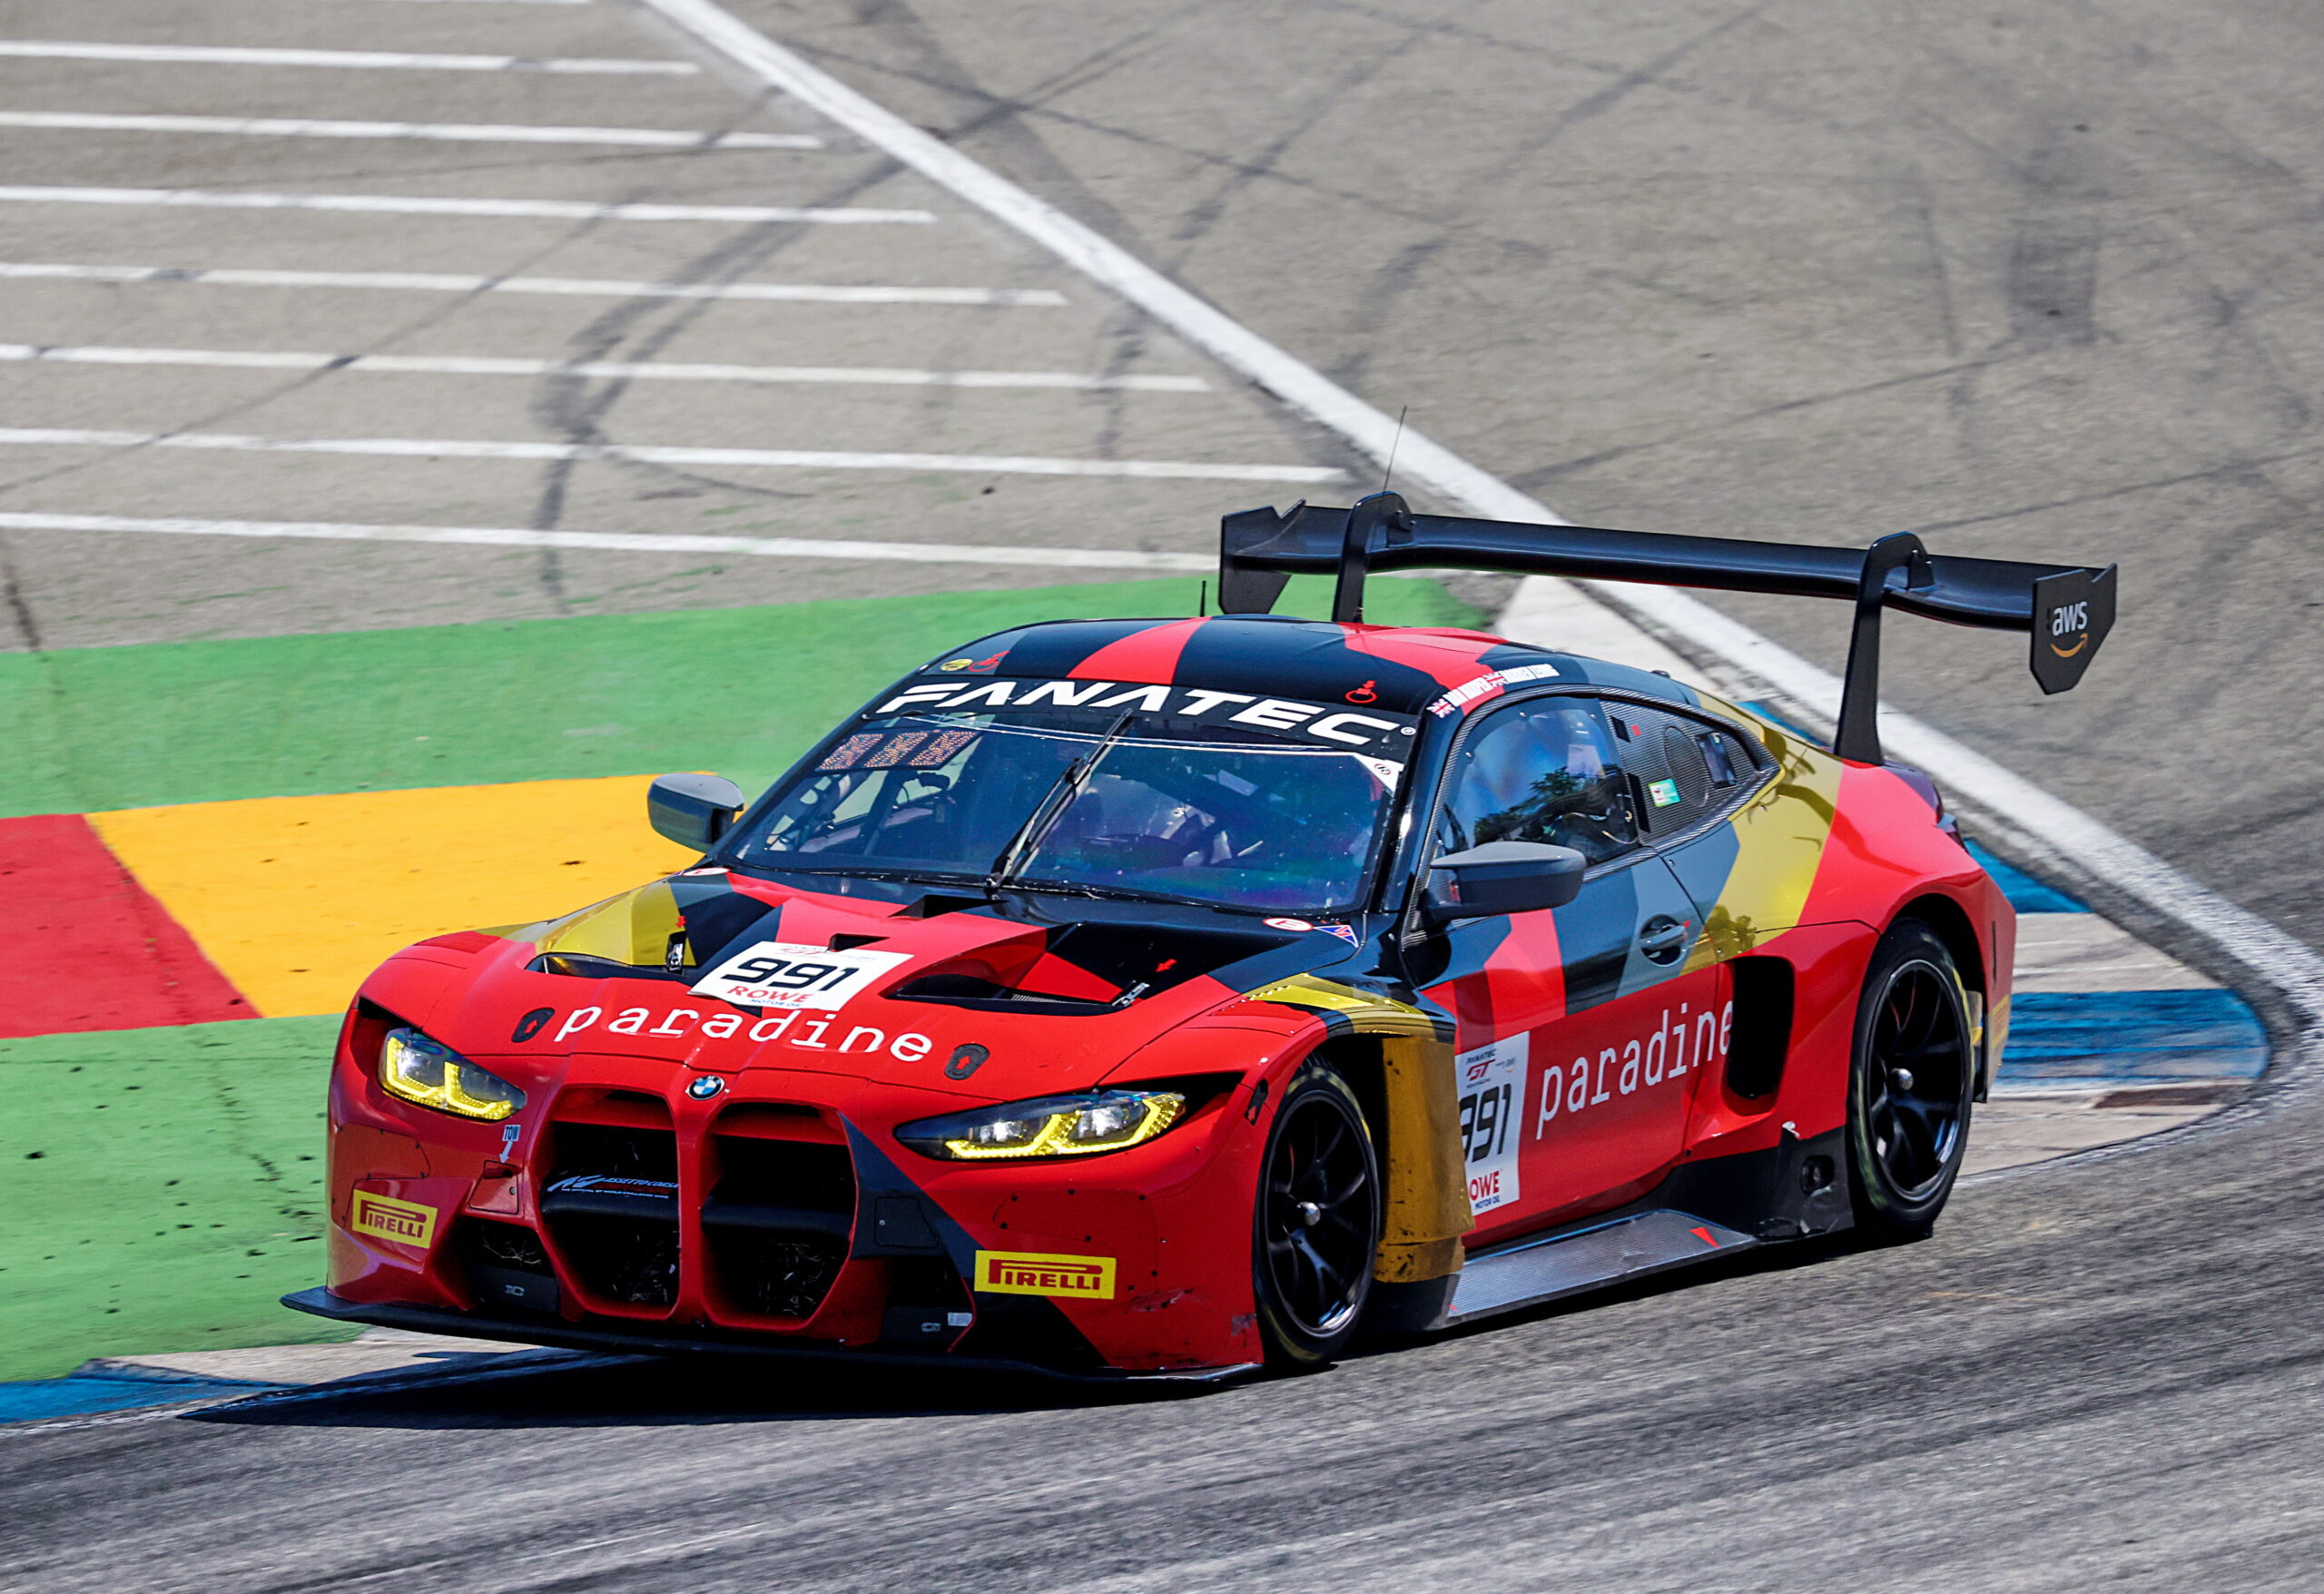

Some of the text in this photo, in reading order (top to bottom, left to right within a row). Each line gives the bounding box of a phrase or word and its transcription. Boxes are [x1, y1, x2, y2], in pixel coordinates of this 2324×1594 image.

[2053, 601, 2087, 636] aws
[875, 680, 1401, 745] FANATEC
[720, 957, 860, 991] 991
[726, 985, 814, 1002] ROWE
[554, 1005, 933, 1063] paradine
[1536, 1000, 1732, 1140] paradine
[1470, 1170, 1500, 1201] OWE
[359, 1199, 427, 1238] PIRELLI
[988, 1259, 1103, 1290] PIRELLI
